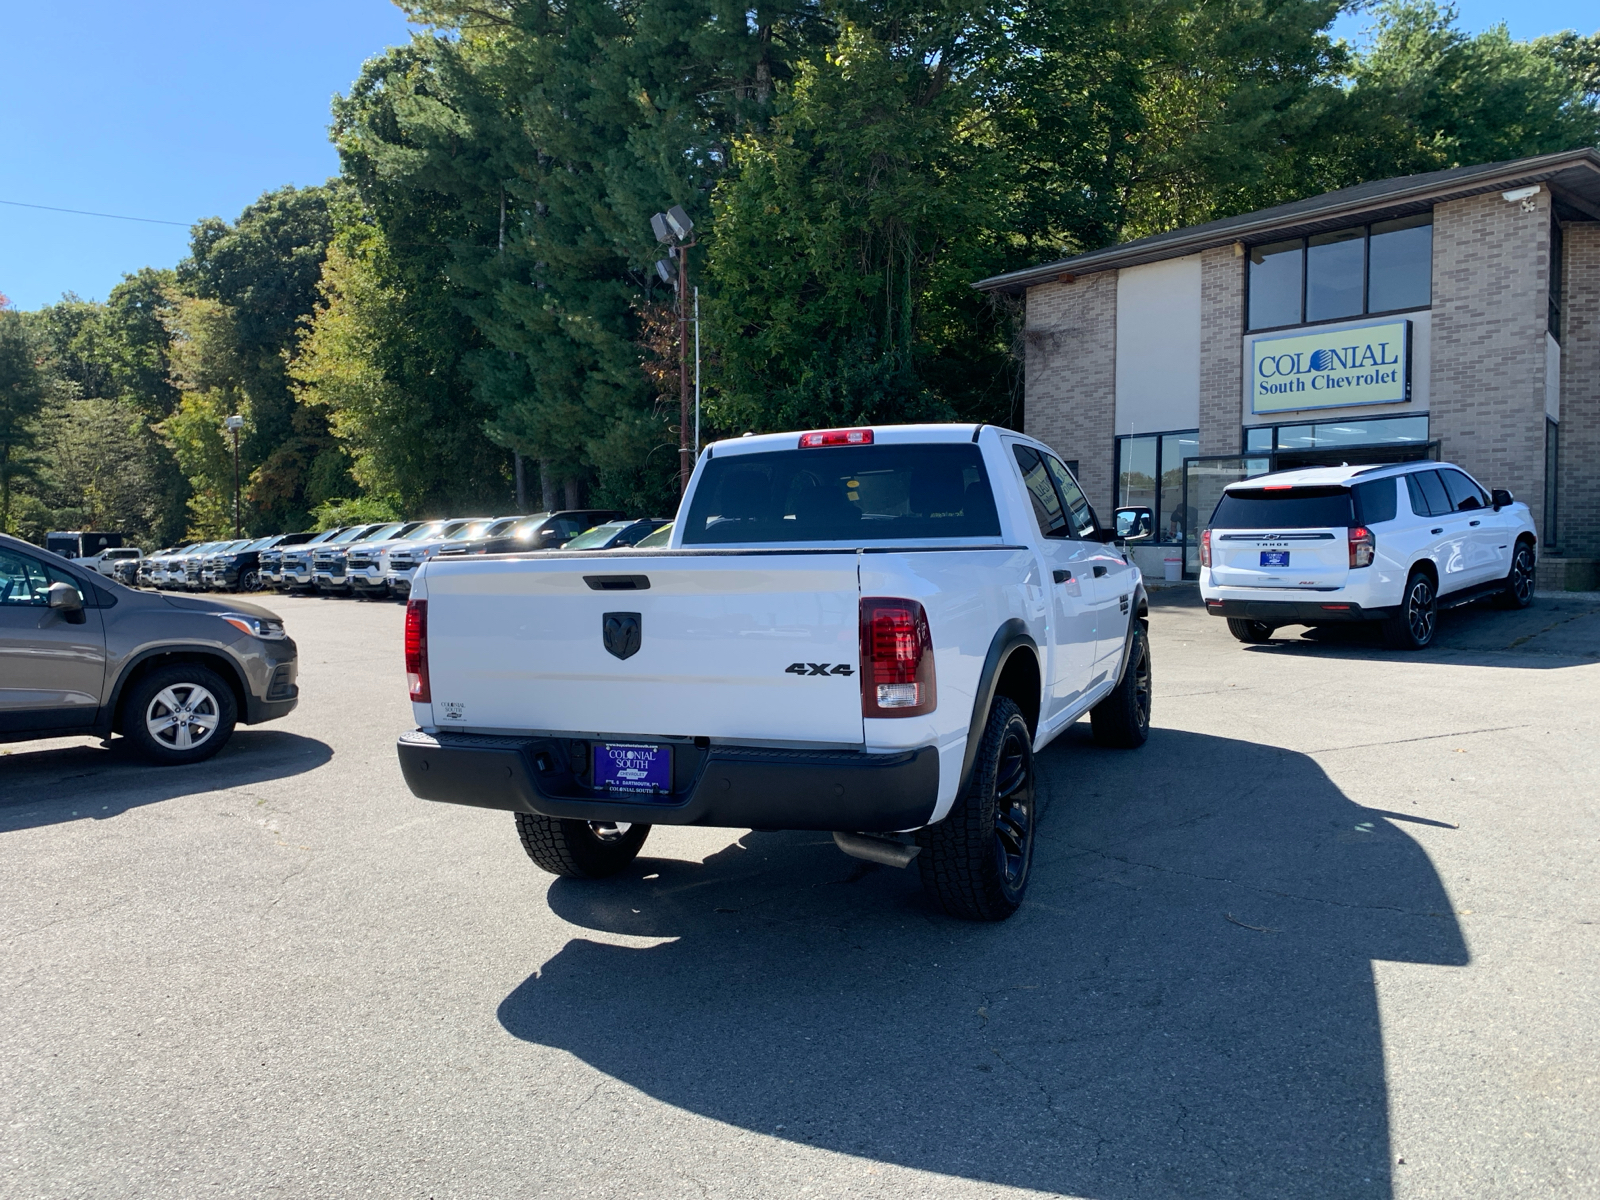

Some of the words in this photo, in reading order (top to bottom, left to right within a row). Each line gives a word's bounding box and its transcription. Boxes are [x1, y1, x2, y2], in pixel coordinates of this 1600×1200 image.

[1258, 342, 1399, 378] COLONIAL
[1259, 378, 1306, 396] South
[1311, 368, 1398, 390] Chevrolet
[609, 750, 656, 760] COLONIAL
[616, 759, 648, 769] SOUTH
